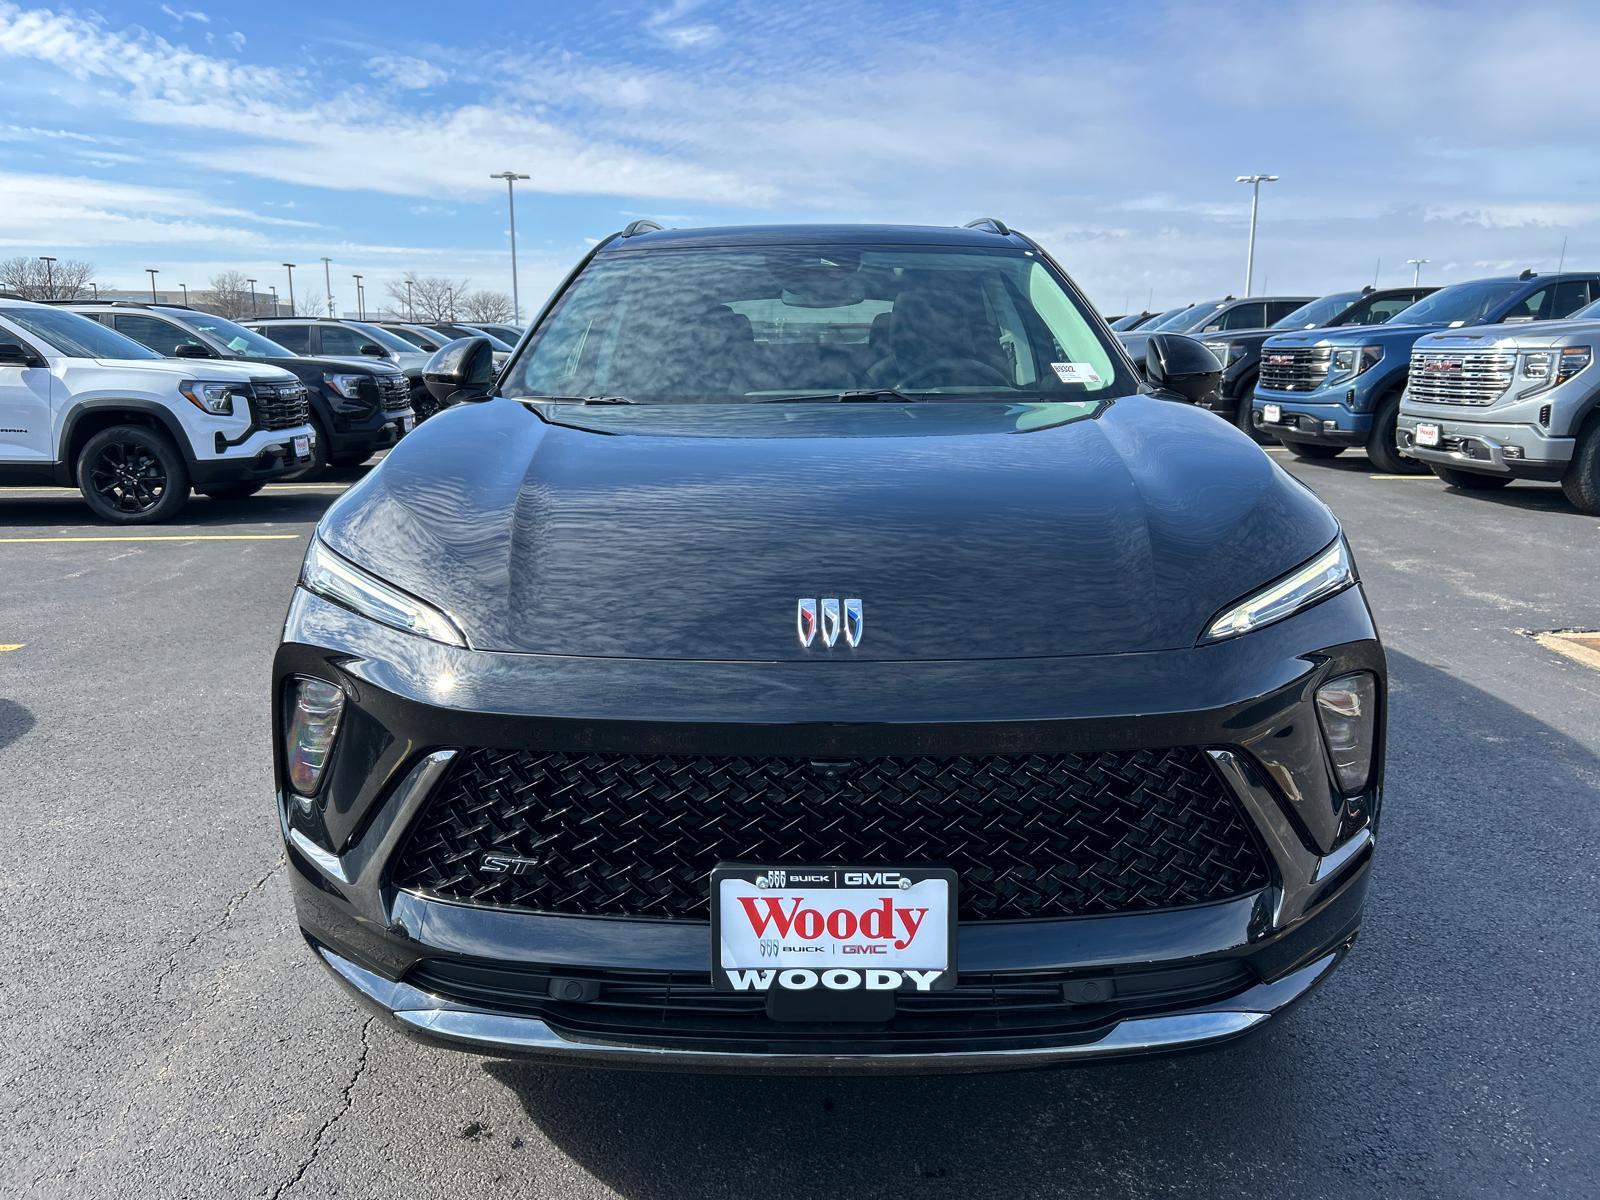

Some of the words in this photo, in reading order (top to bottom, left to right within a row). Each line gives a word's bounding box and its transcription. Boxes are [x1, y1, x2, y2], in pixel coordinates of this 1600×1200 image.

[1270, 355, 1294, 365] GMC
[1425, 360, 1463, 372] GMC
[480, 857, 538, 874] ST
[844, 872, 901, 885] GMC
[737, 897, 930, 950] Woody
[842, 944, 888, 955] GMC
[725, 968, 943, 991] WOODY
